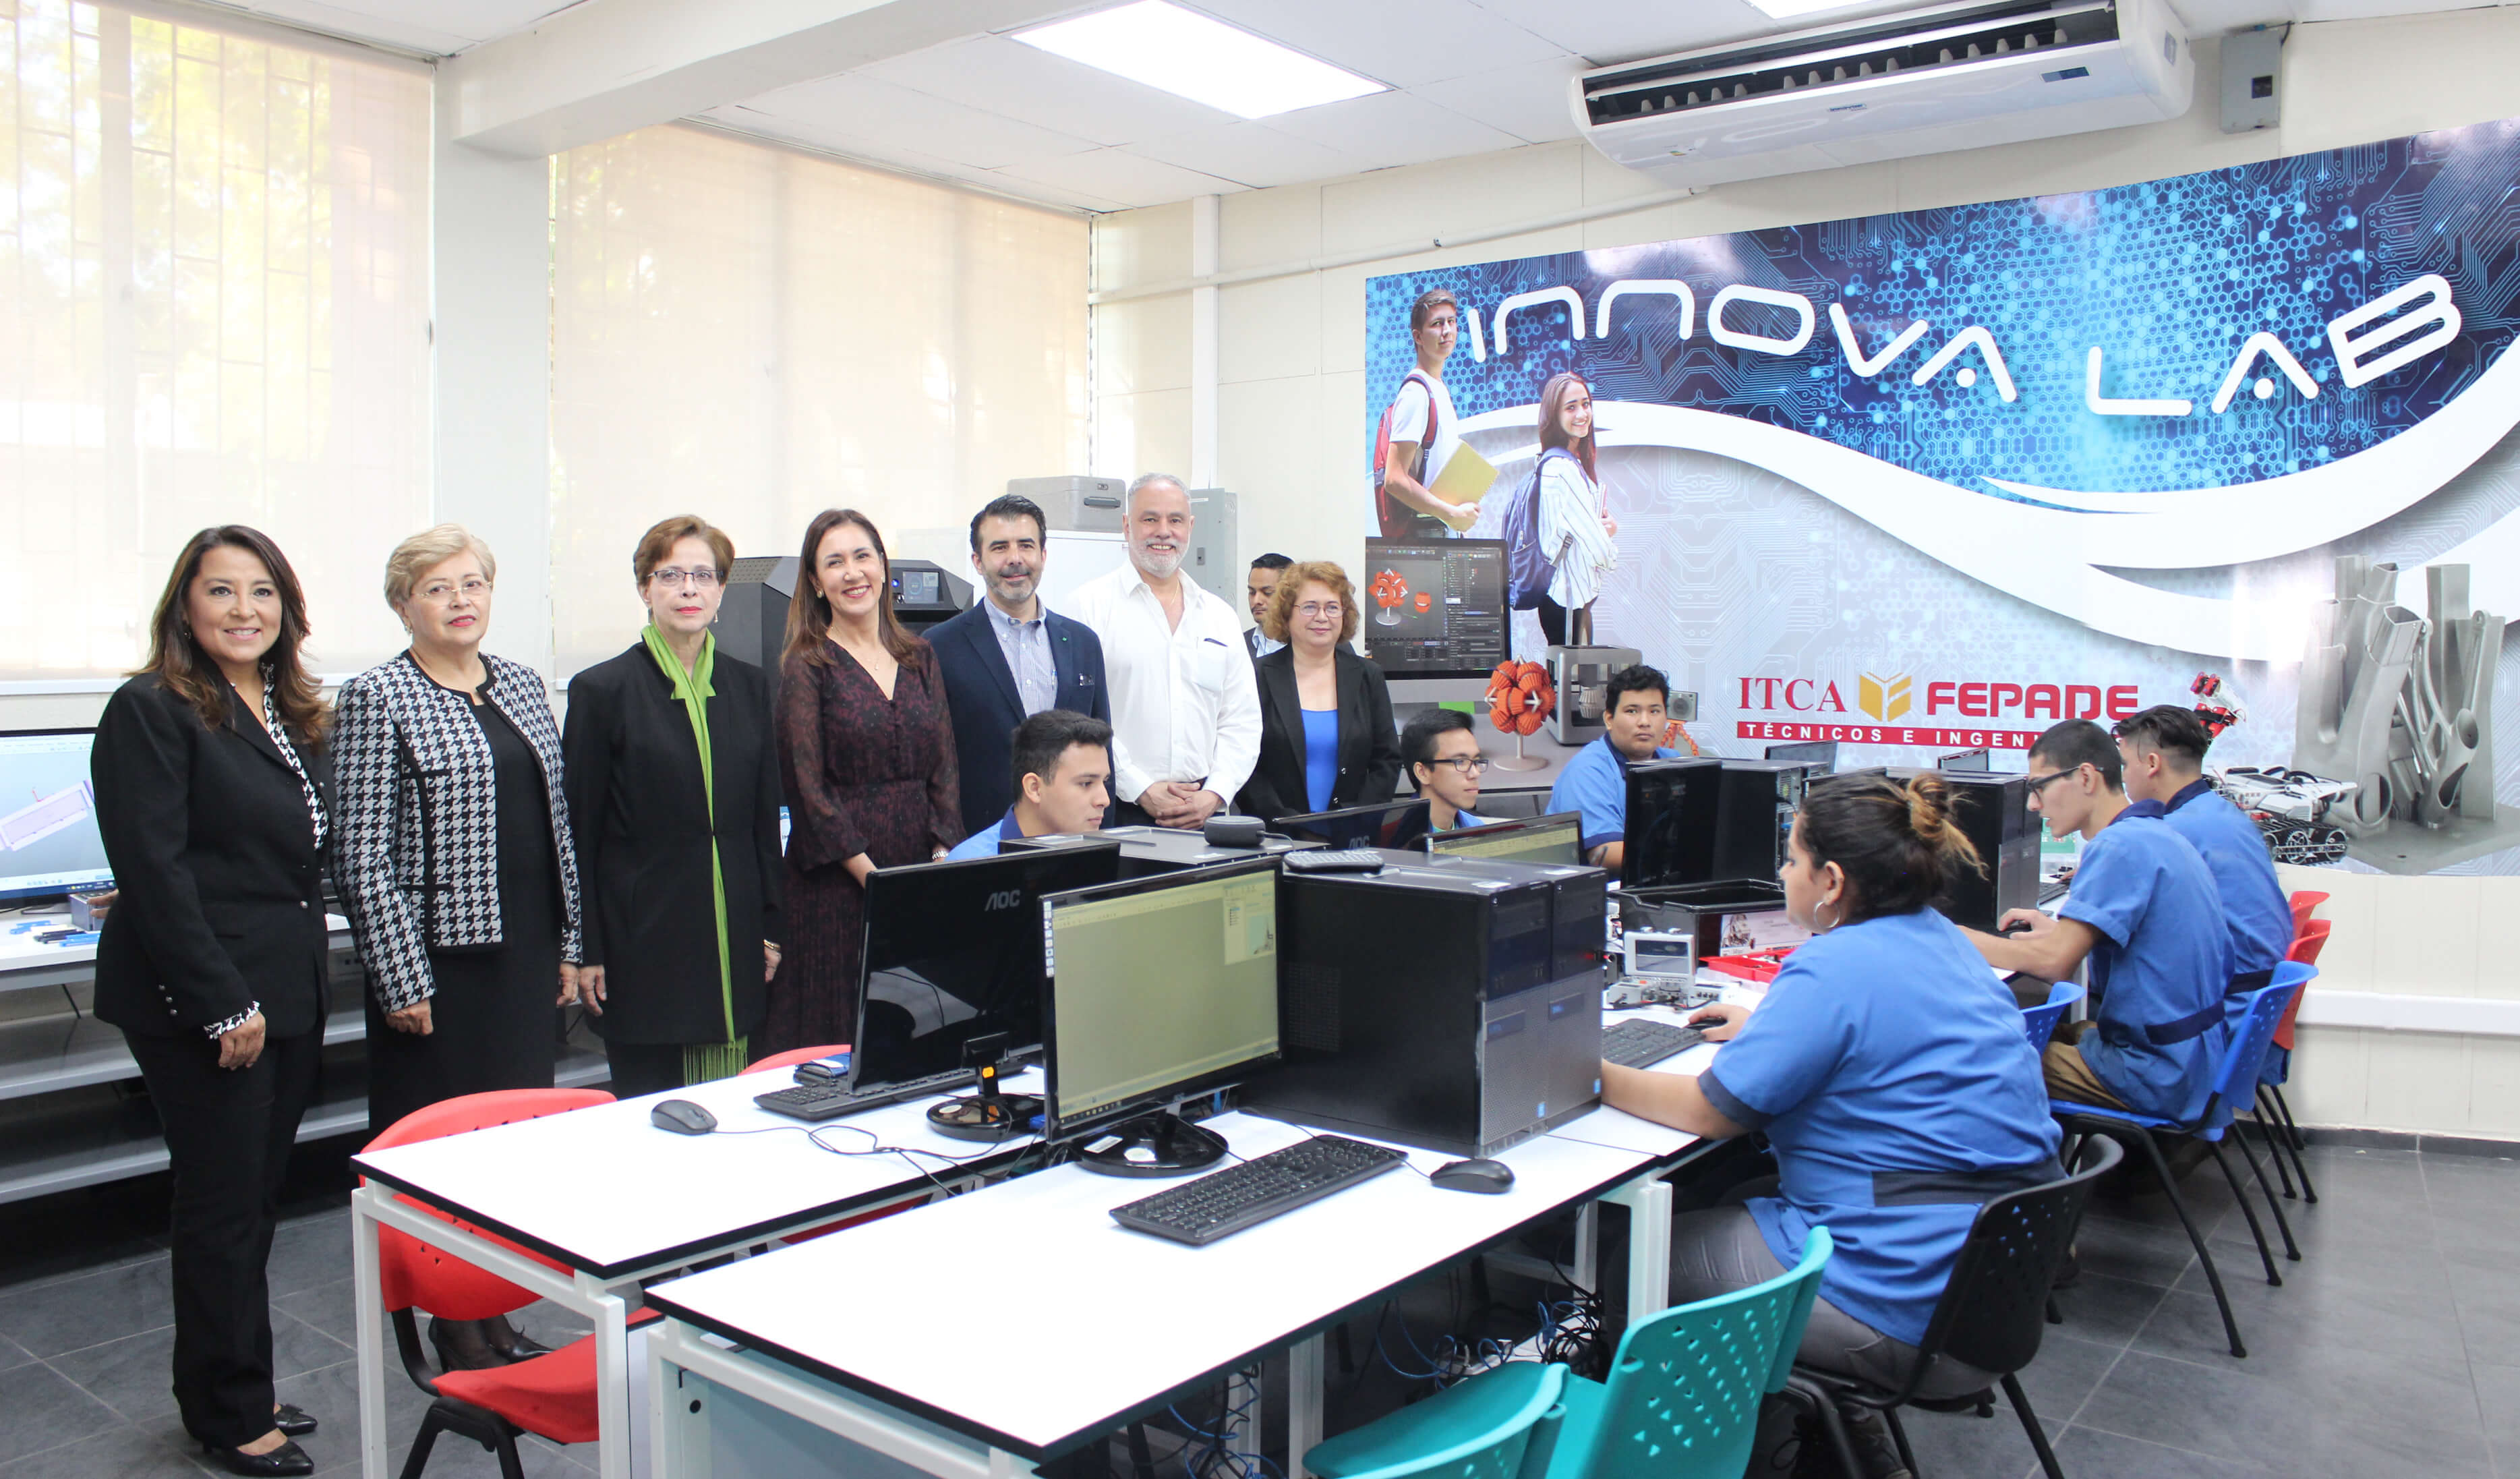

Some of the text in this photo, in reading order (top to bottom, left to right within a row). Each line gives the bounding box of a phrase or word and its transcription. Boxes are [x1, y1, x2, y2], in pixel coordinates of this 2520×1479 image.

[2086, 274, 2461, 415] LAB
[1737, 677, 2138, 721] ITCA FEPADE
[1746, 722, 1882, 742] TÉCNICOS
[1903, 730, 1914, 743] E
[985, 890, 1020, 912] AOC
